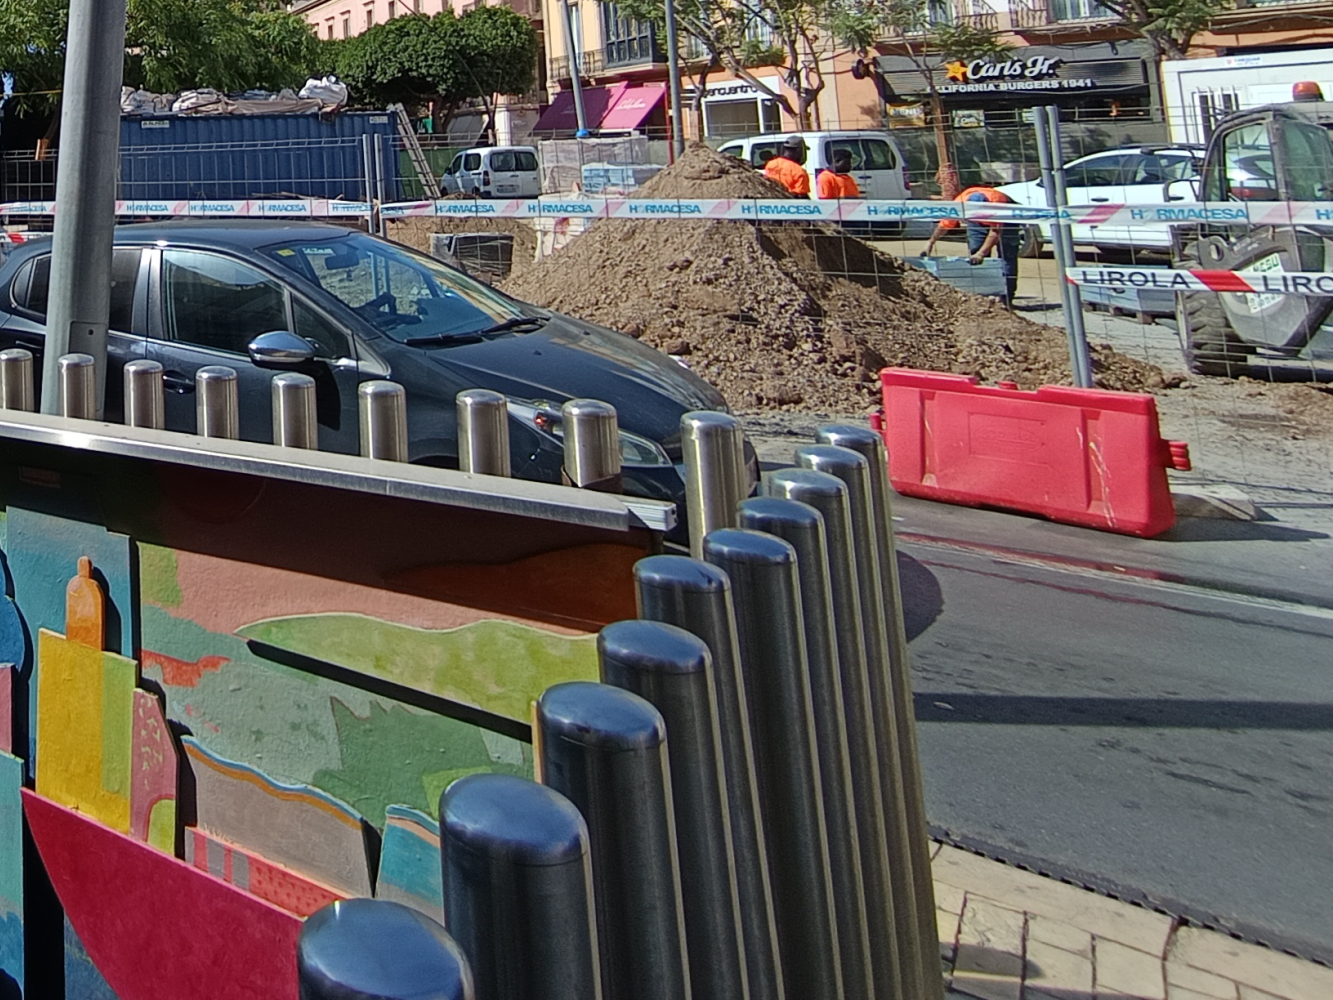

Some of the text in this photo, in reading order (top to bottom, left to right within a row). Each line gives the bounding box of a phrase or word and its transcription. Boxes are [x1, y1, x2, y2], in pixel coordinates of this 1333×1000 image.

[1024, 55, 1060, 77] Jr.
[926, 78, 1093, 94] CLIFORNIA BURGERS 1941
[1081, 270, 1191, 289] LIROLA
[1262, 275, 1333, 295] LIRO
